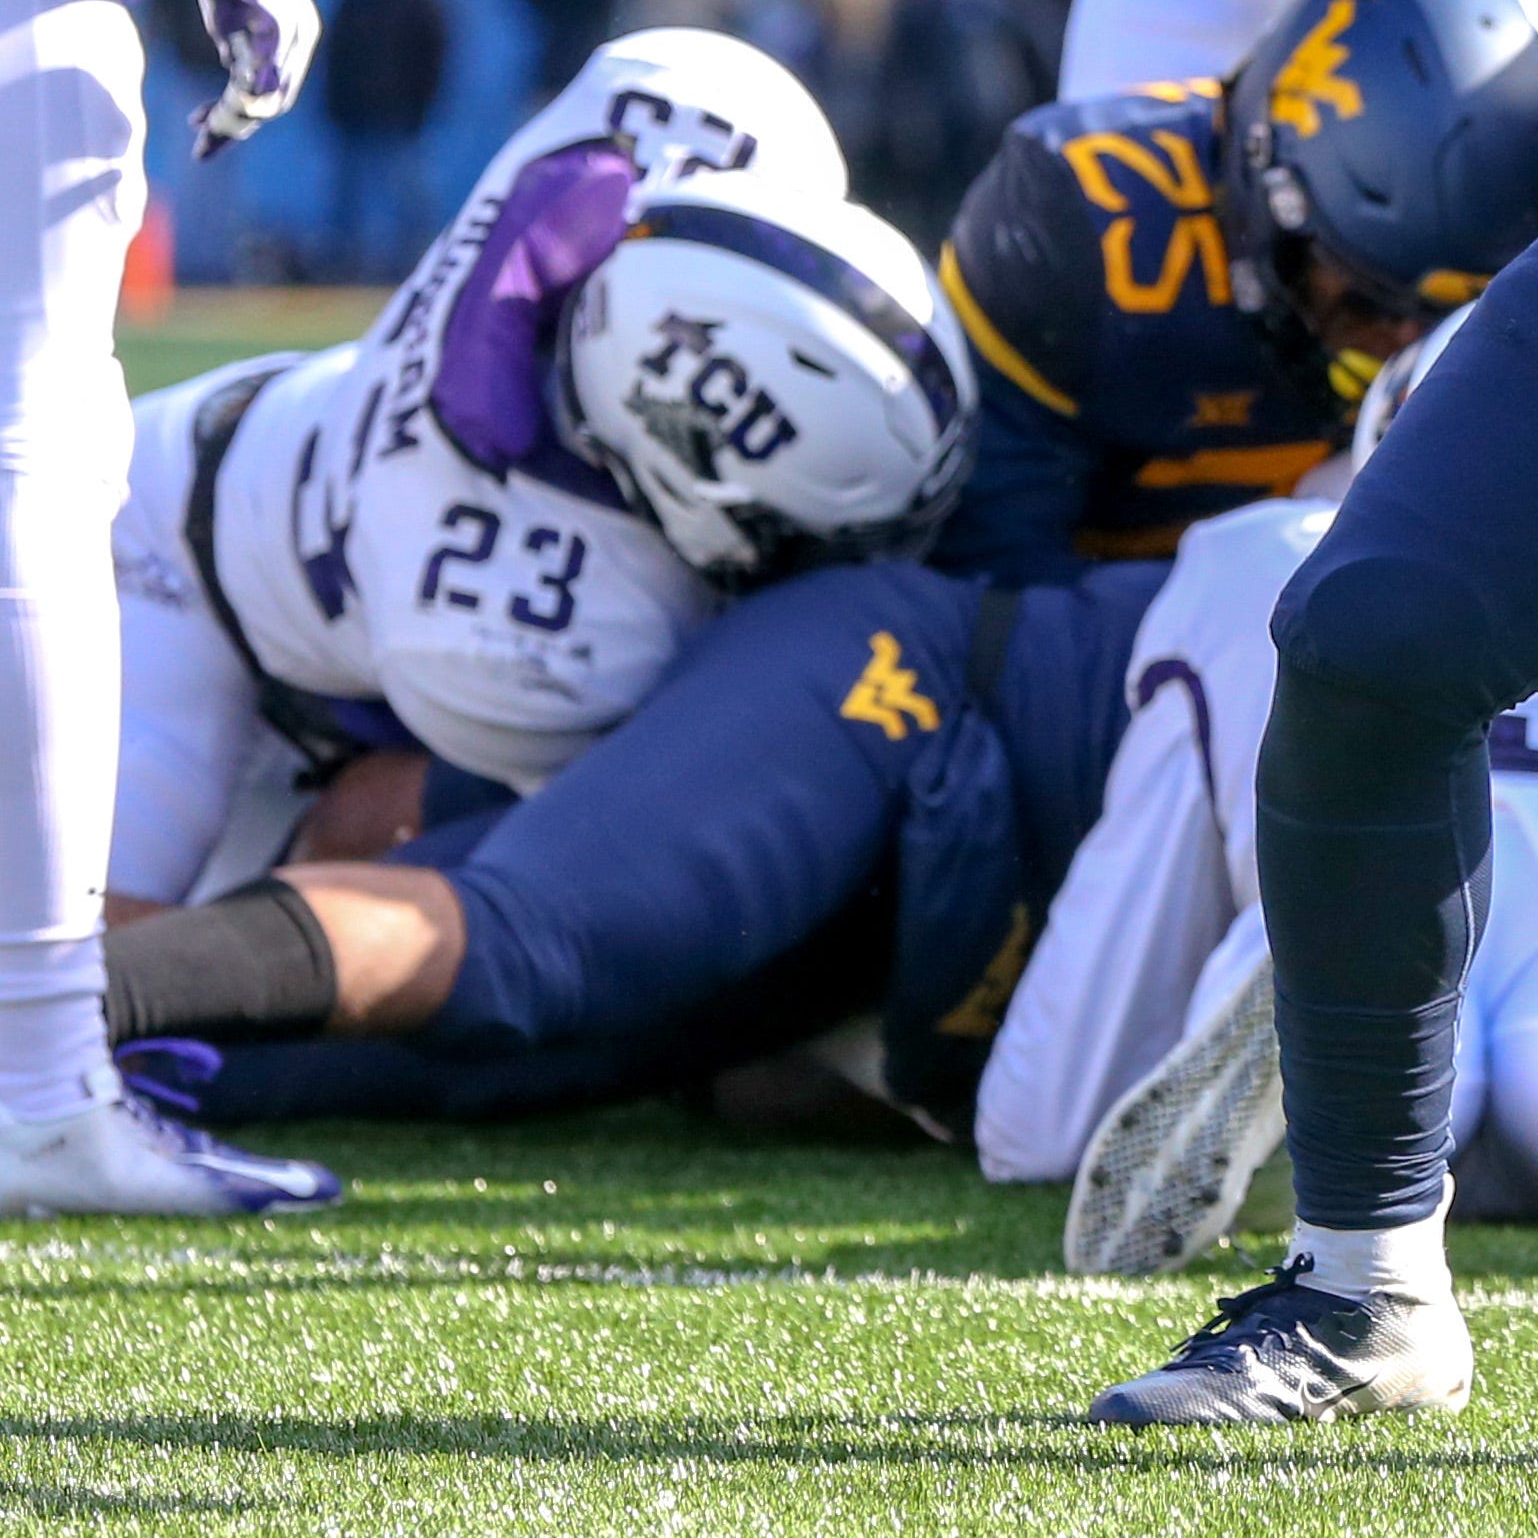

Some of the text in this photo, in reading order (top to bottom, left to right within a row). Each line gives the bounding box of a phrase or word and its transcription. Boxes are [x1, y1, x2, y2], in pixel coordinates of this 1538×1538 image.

[1064, 130, 1230, 312] 25
[640, 309, 798, 461] TCU
[421, 503, 585, 632] 23
